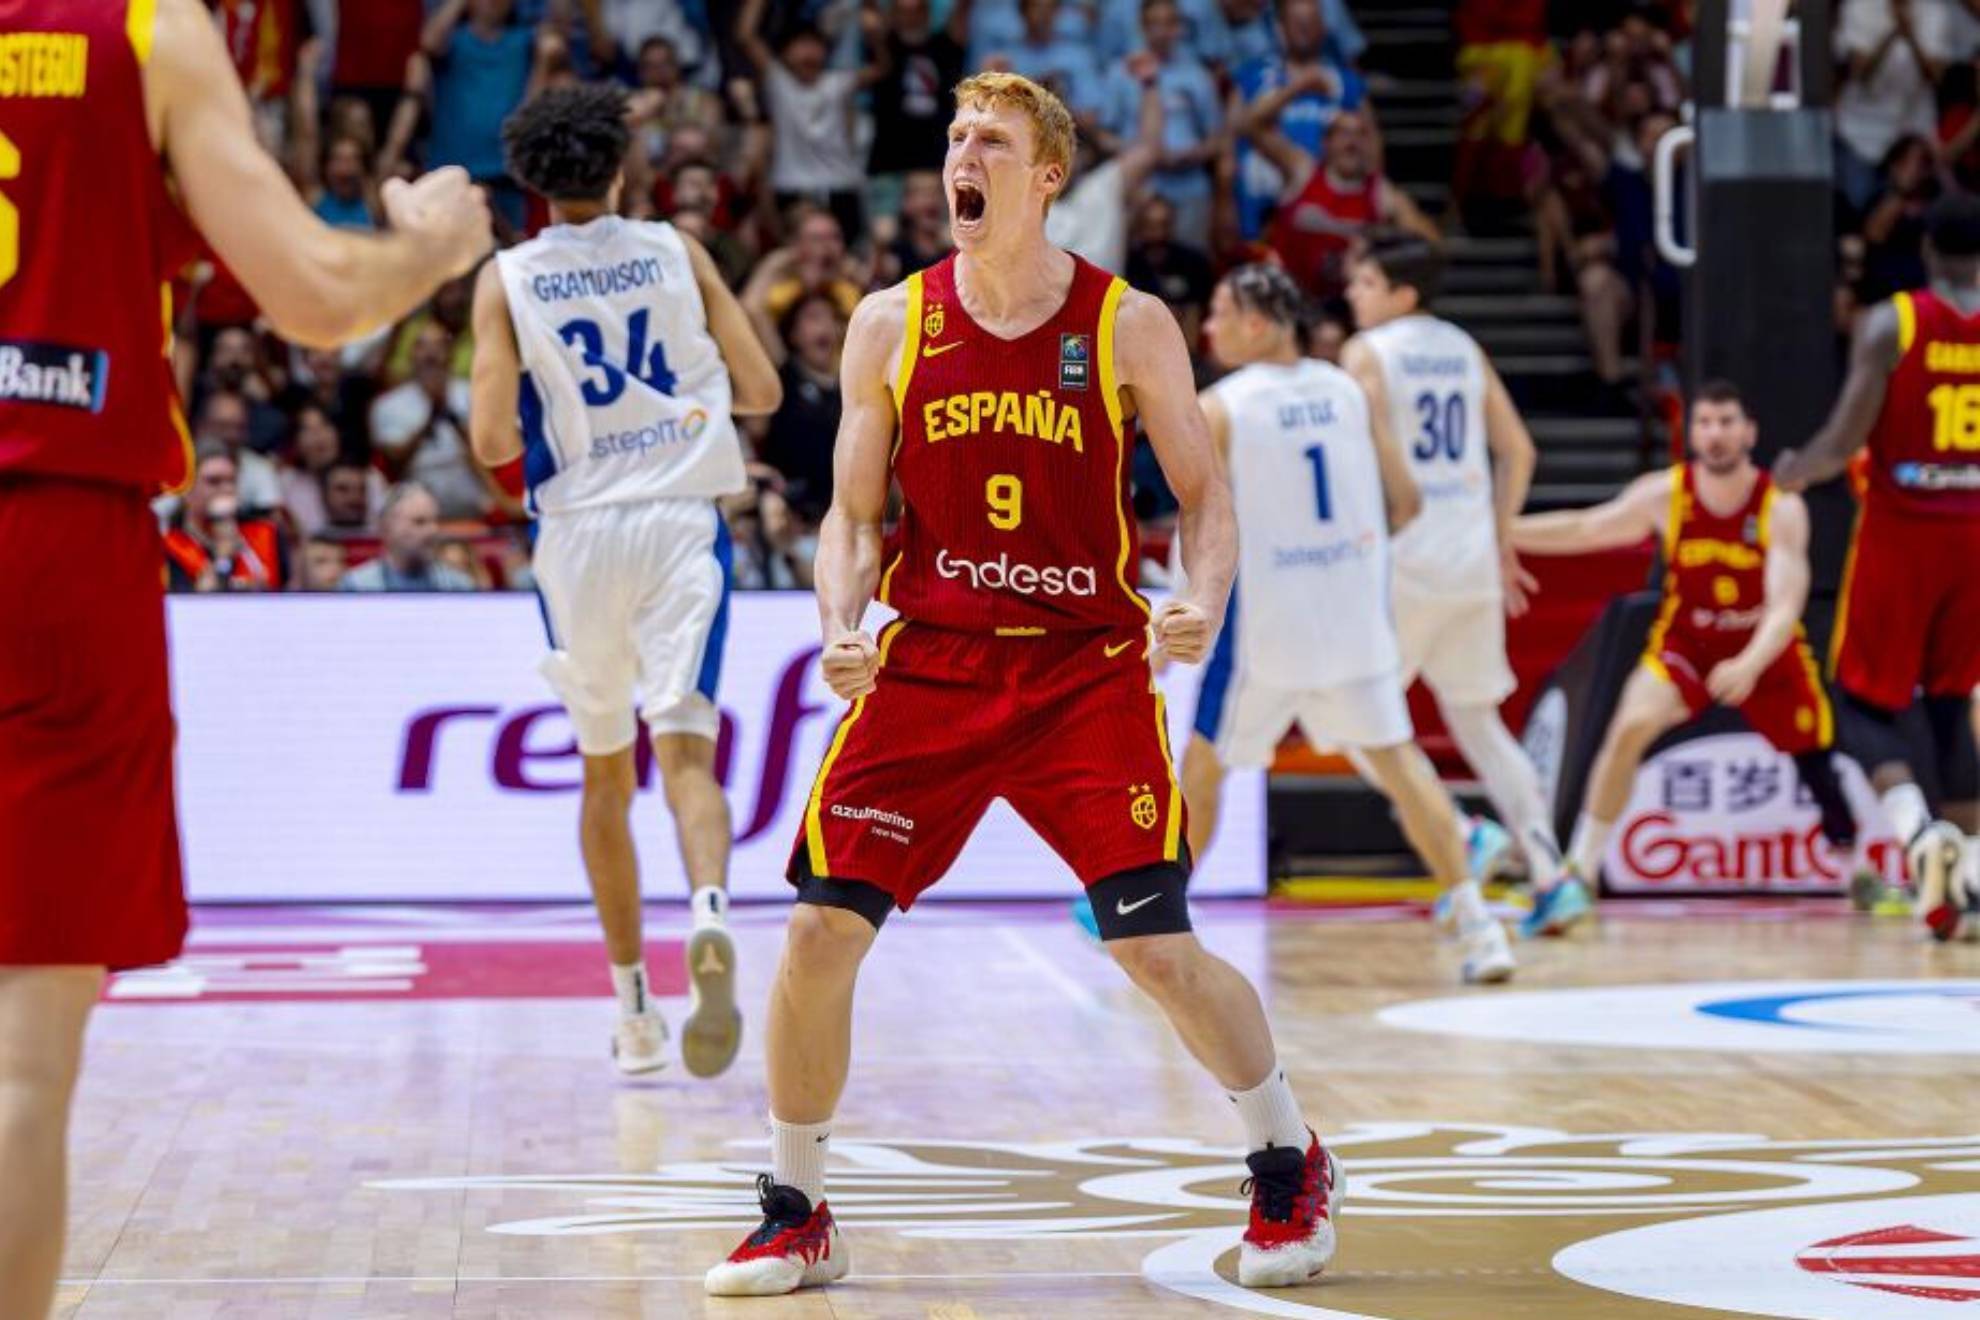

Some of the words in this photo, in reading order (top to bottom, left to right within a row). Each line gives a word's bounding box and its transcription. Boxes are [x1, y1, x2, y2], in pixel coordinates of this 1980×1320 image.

[533, 257, 664, 302] GRANDISON
[0, 344, 91, 406] Bank
[558, 308, 677, 406] 34
[923, 389, 1083, 453] ESPAÑA
[1413, 390, 1466, 462] 30
[985, 474, 1023, 530] 9
[1303, 442, 1332, 522] 1
[936, 549, 1096, 595] endesa
[831, 804, 914, 830] azulmarino
